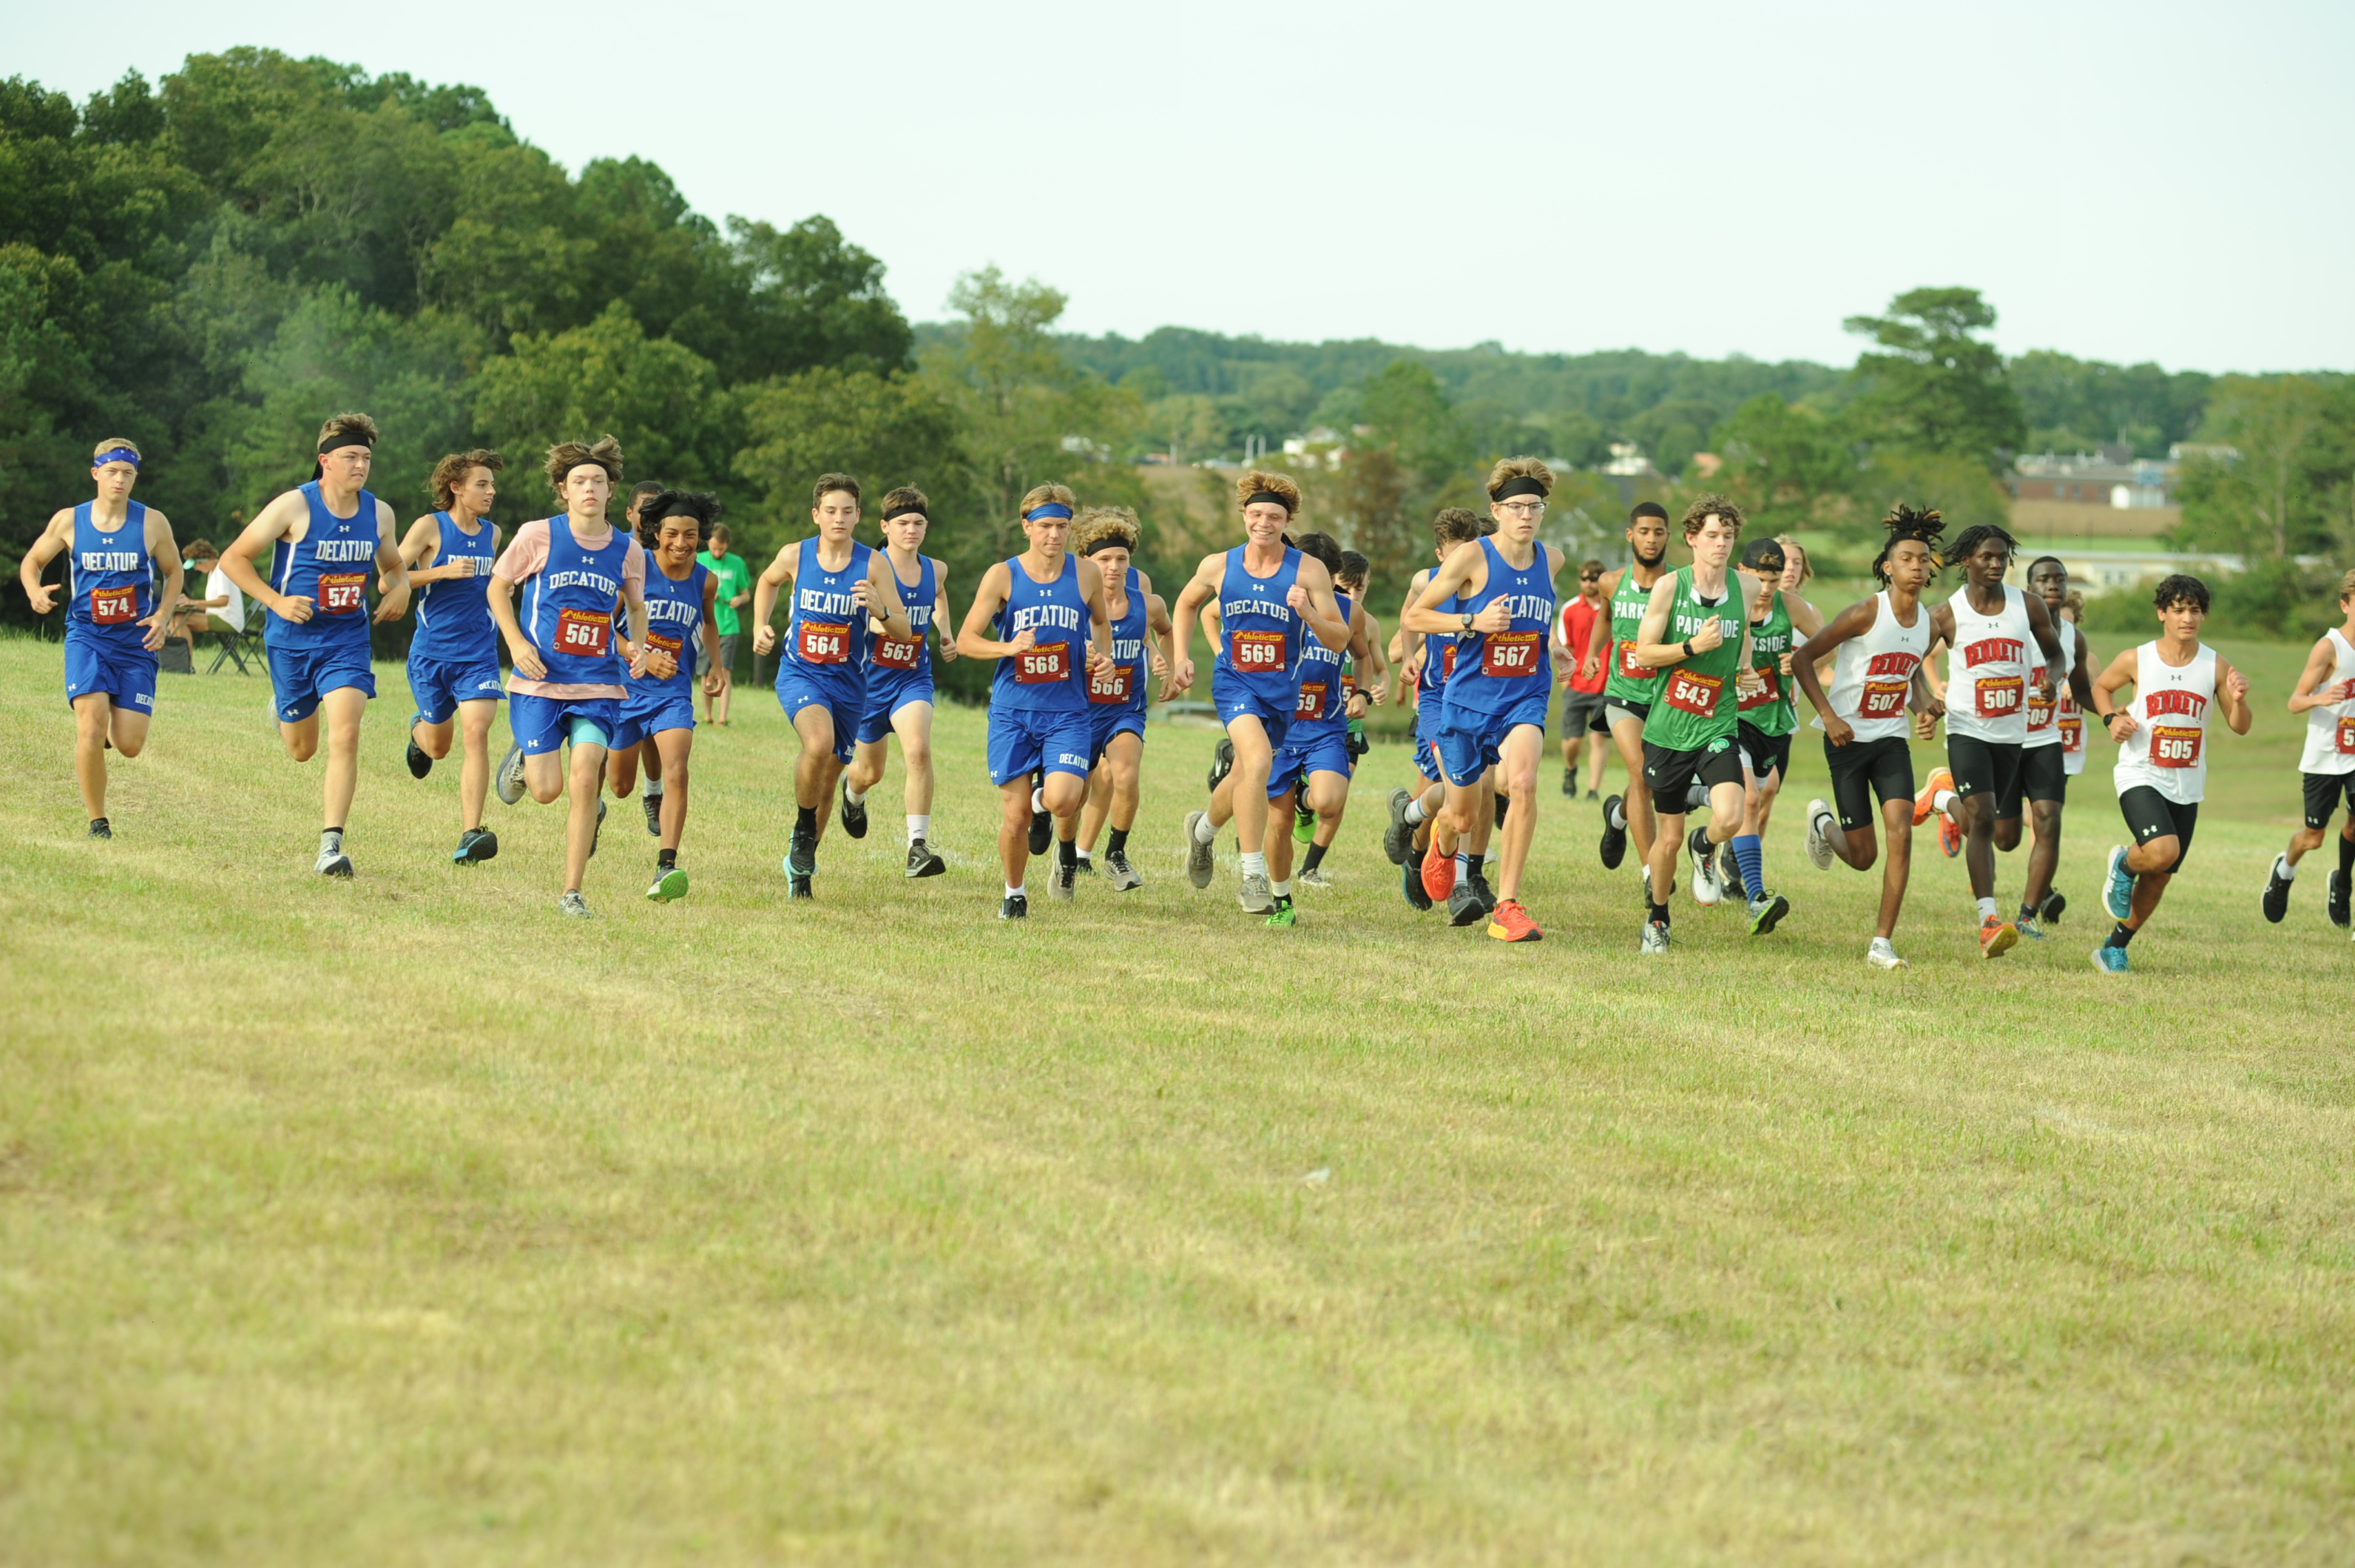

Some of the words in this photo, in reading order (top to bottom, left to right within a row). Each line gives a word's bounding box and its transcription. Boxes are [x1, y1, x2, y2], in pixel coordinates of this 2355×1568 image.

[316, 540, 373, 561] DECATUR
[81, 552, 138, 572] DECATUR
[549, 570, 616, 597] DECATUR
[98, 597, 129, 616] 574
[328, 586, 361, 606] 573
[800, 588, 859, 615] DECATUR
[1013, 605, 1079, 632] DECATUR
[1226, 599, 1289, 622] DECATUR
[565, 623, 599, 646] 561
[806, 634, 839, 655] 564
[882, 641, 914, 661] 563
[1241, 643, 1276, 663] 569
[1493, 645, 1530, 666] 567
[1964, 638, 2024, 669] BENNETT
[1024, 655, 1059, 674] 568
[1091, 677, 1124, 695] 566
[1675, 680, 1711, 707] 543
[1868, 693, 1901, 712] 507
[1984, 689, 2017, 709] 506
[2146, 689, 2207, 721] BENNETT
[2158, 738, 2194, 760] 505
[1058, 753, 1089, 771] DECATUR
